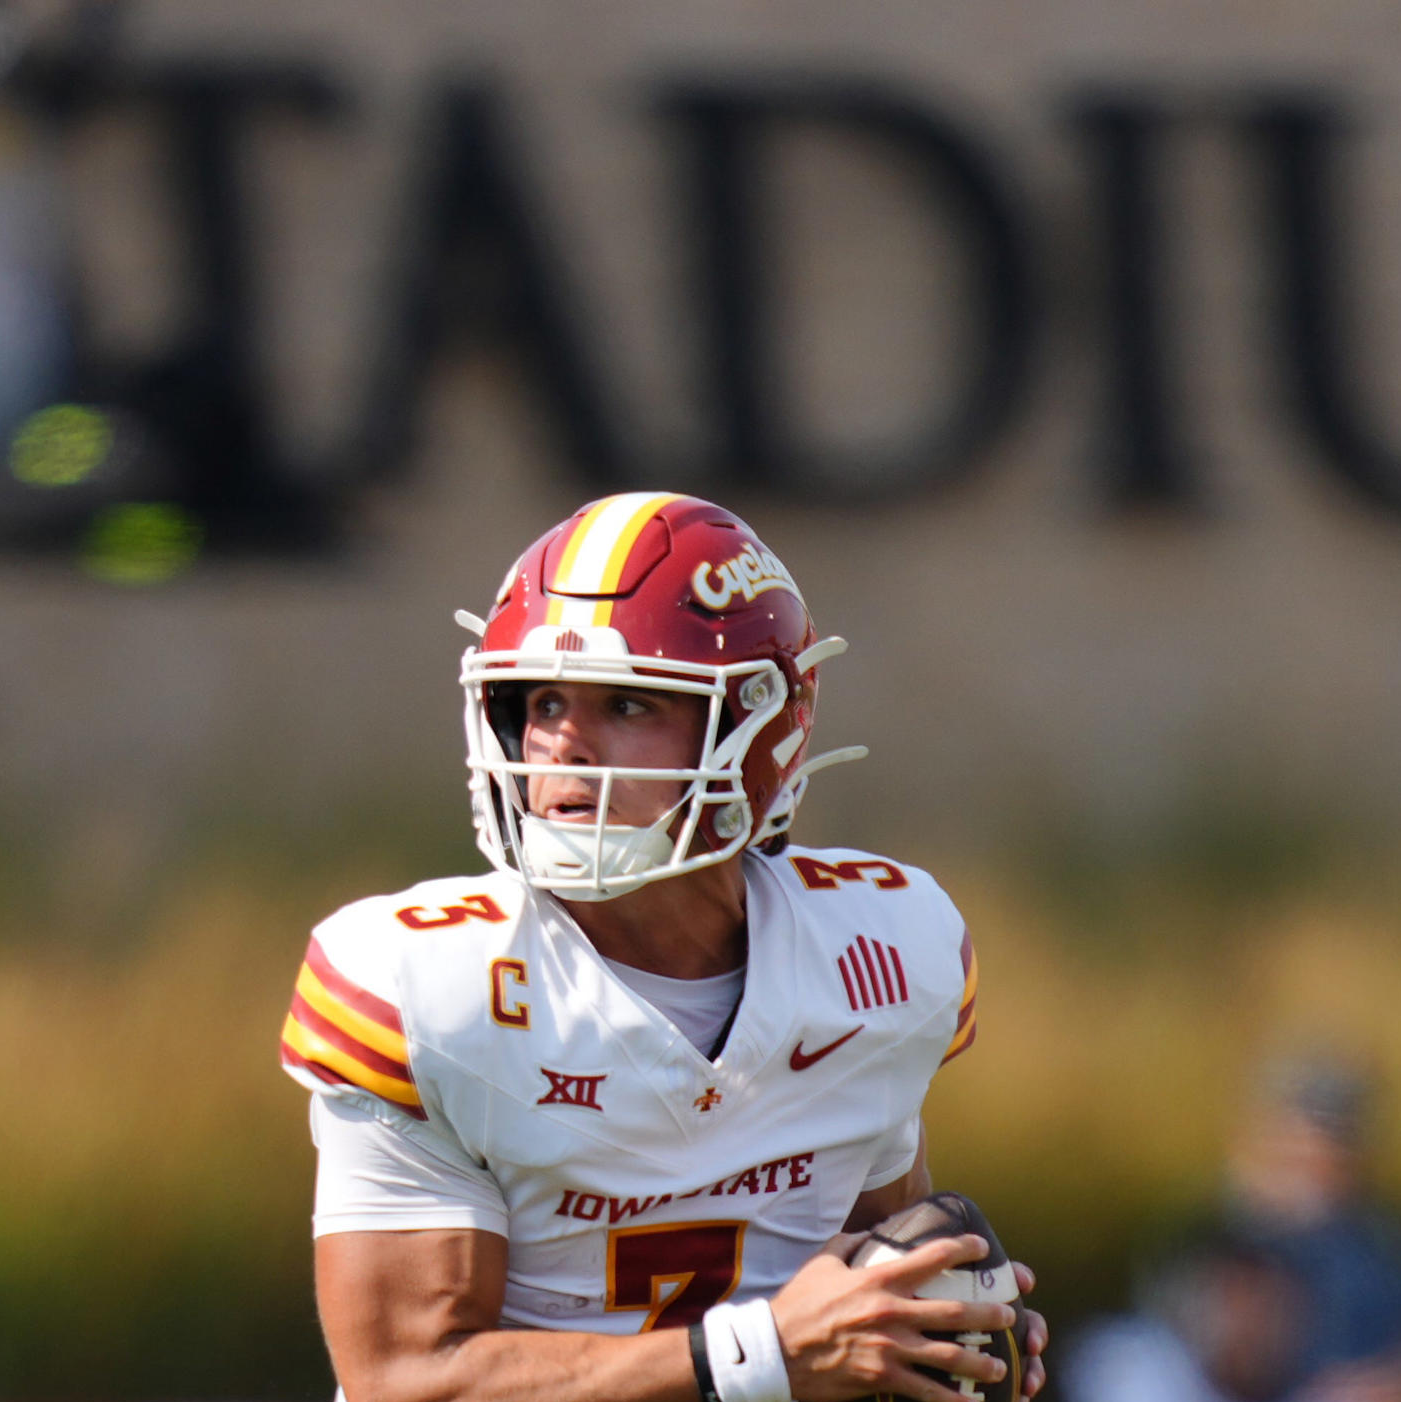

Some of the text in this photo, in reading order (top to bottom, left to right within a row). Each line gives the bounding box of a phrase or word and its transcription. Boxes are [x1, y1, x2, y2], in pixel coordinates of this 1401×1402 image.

[787, 855, 910, 891] 3
[395, 893, 510, 931] 3
[490, 956, 532, 1031] C
[535, 1066, 609, 1113] XII
